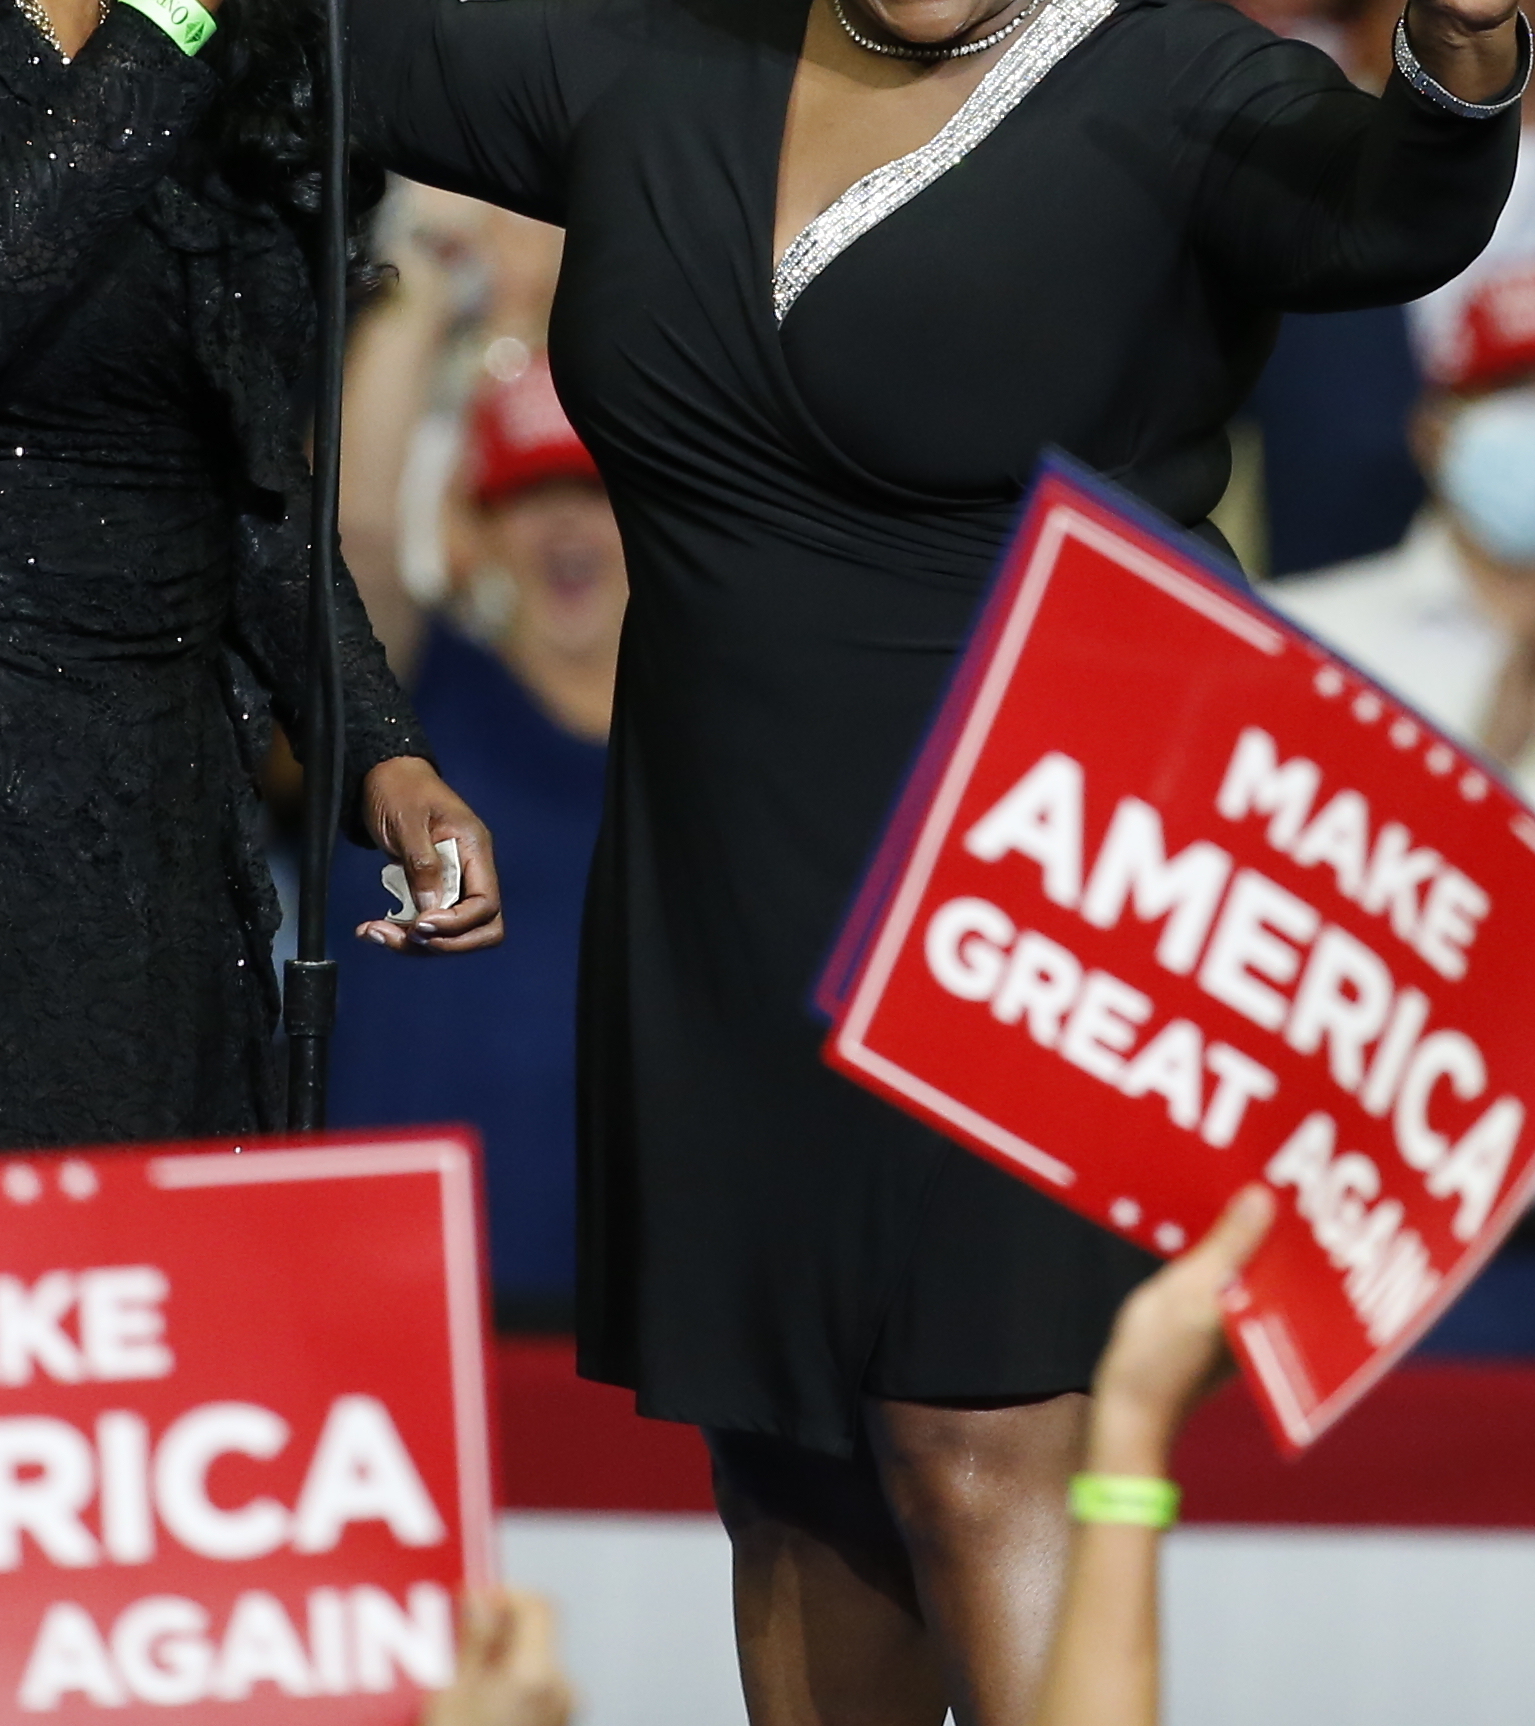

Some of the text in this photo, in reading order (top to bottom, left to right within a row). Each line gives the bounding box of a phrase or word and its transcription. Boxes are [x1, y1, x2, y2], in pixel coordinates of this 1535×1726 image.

[963, 750, 1525, 1240] AMERICA
[1215, 726, 1492, 982] MAKE
[923, 896, 1440, 1347] GREAT AGAIN
[18, 1581, 456, 1712] AGAIN
